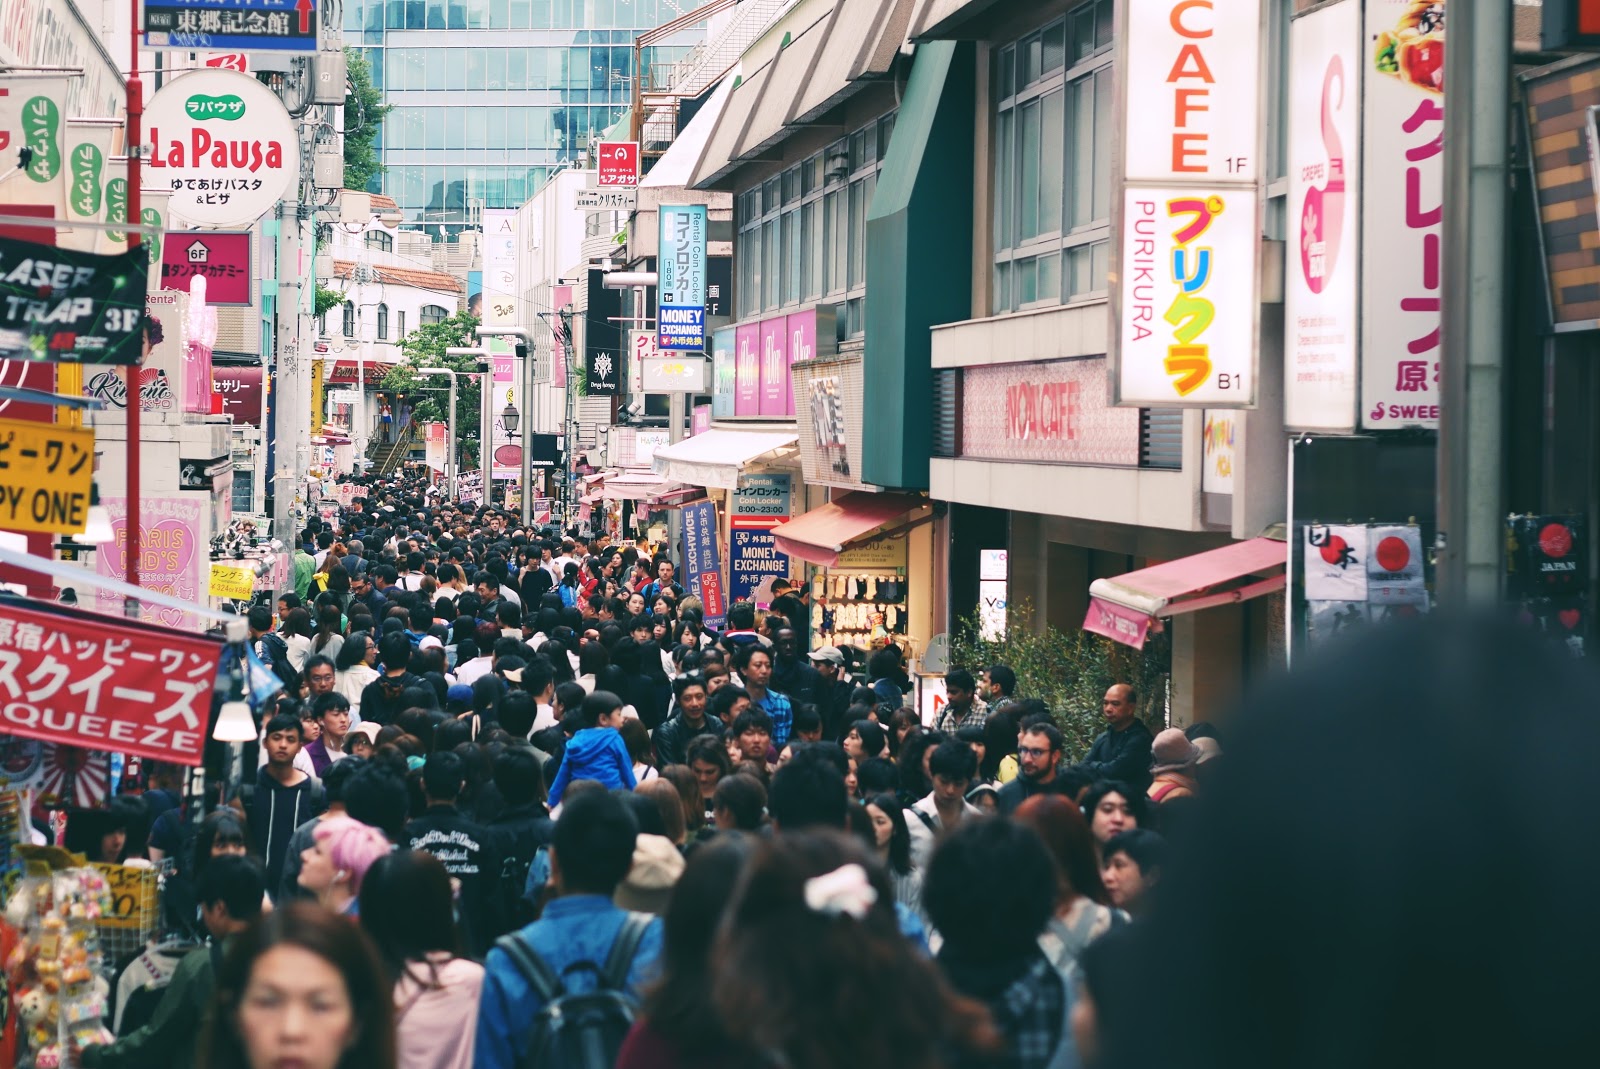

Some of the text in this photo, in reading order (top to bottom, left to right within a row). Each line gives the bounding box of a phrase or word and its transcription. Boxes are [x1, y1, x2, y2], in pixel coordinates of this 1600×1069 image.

[176, 9, 290, 35] 東郷記念館
[1166, 0, 1216, 173] CAFE
[186, 100, 244, 114] ラパウザ
[31, 99, 51, 181] ラパウザ
[150, 127, 283, 173] La Pausa
[1225, 157, 1248, 174] 1F
[79, 146, 95, 215] ラパウザ
[170, 178, 263, 191] ゆであげパスタ
[607, 174, 637, 184] アガサ
[598, 194, 635, 207] クリスティー
[190, 249, 205, 259] 6F
[675, 212, 690, 303] コインロッカー
[691, 212, 702, 304] Rental Coin Locker
[0, 258, 96, 289] ASER
[1132, 200, 1156, 342] PURIKURA
[664, 293, 673, 302] 1F
[1163, 195, 1225, 398] プリクラ
[6, 296, 140, 332] TRAP 3F
[661, 309, 703, 324] MONEY
[660, 324, 703, 335] EXCHANGE
[1217, 373, 1242, 390] B1
[1389, 404, 1440, 420] SWEE
[748, 478, 772, 486] Rental
[733, 487, 788, 496] コインロッカー
[32, 488, 85, 526] ONE
[757, 497, 783, 505] Locker
[751, 535, 775, 544] 外貨両
[742, 547, 777, 559] MONEY
[734, 559, 785, 571] EXCHANGE
[1540, 561, 1576, 572] JAPAN
[212, 568, 253, 581] サングラス
[0, 702, 202, 754] QUEEZE
